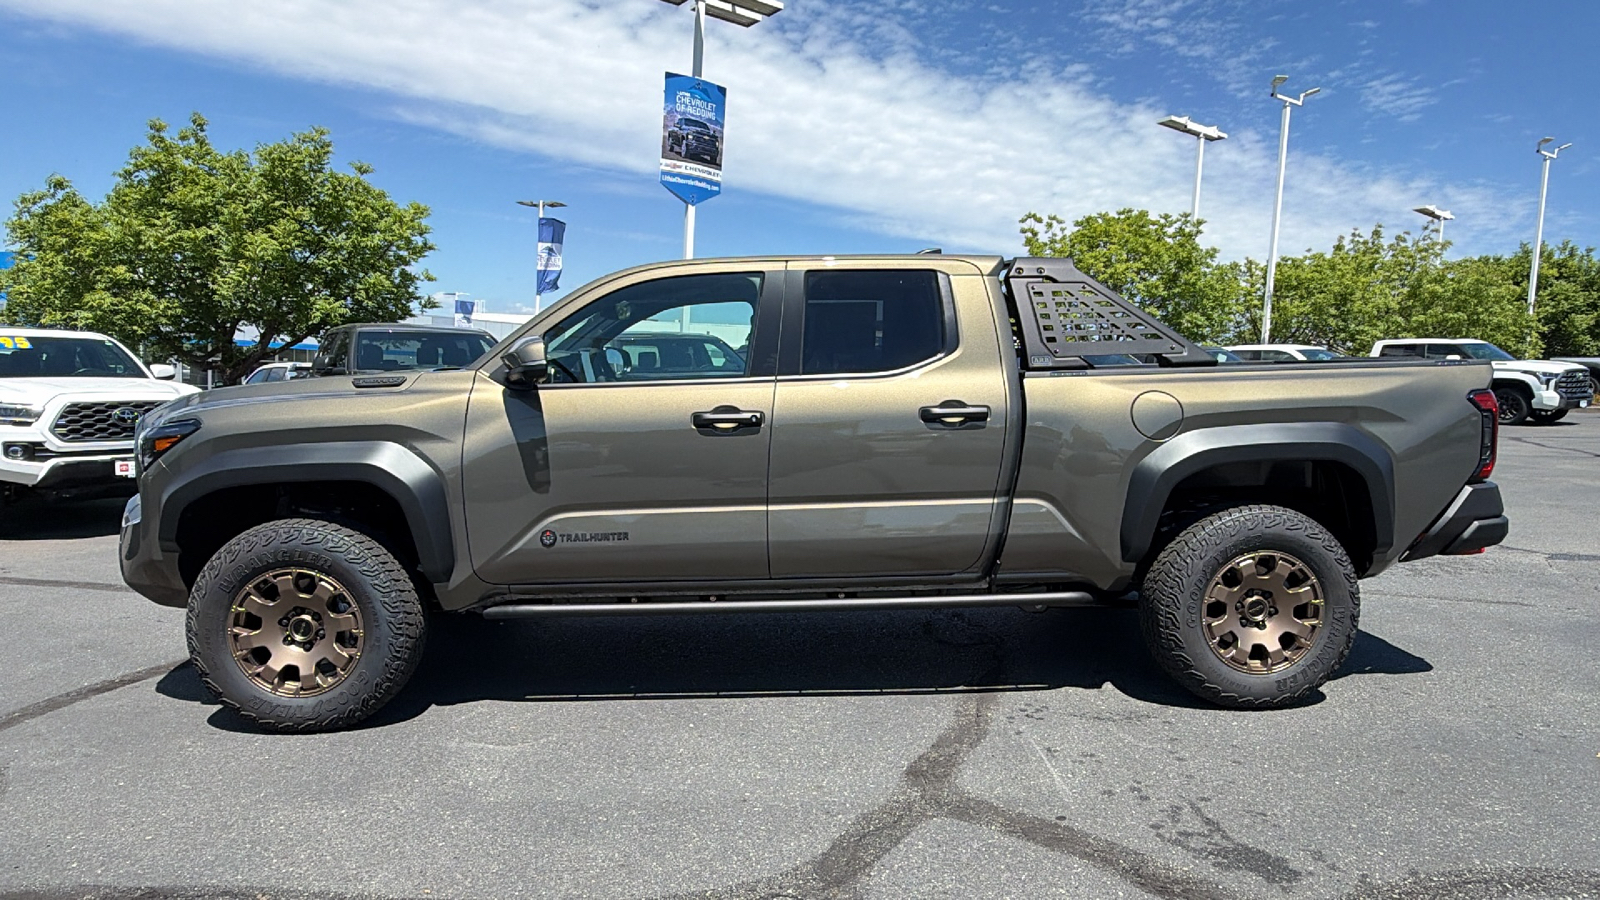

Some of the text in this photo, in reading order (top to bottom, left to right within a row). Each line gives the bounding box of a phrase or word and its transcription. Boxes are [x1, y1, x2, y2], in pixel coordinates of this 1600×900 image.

[676, 94, 717, 112] CHEVROLET
[676, 103, 716, 120] OF REDDING
[684, 165, 719, 177] CHEVROLET
[559, 532, 629, 542] TRAILHUNTER
[219, 548, 332, 594] WRANGLER
[1275, 606, 1346, 692] WRANGLER
[249, 669, 370, 719] GOODYEAR
